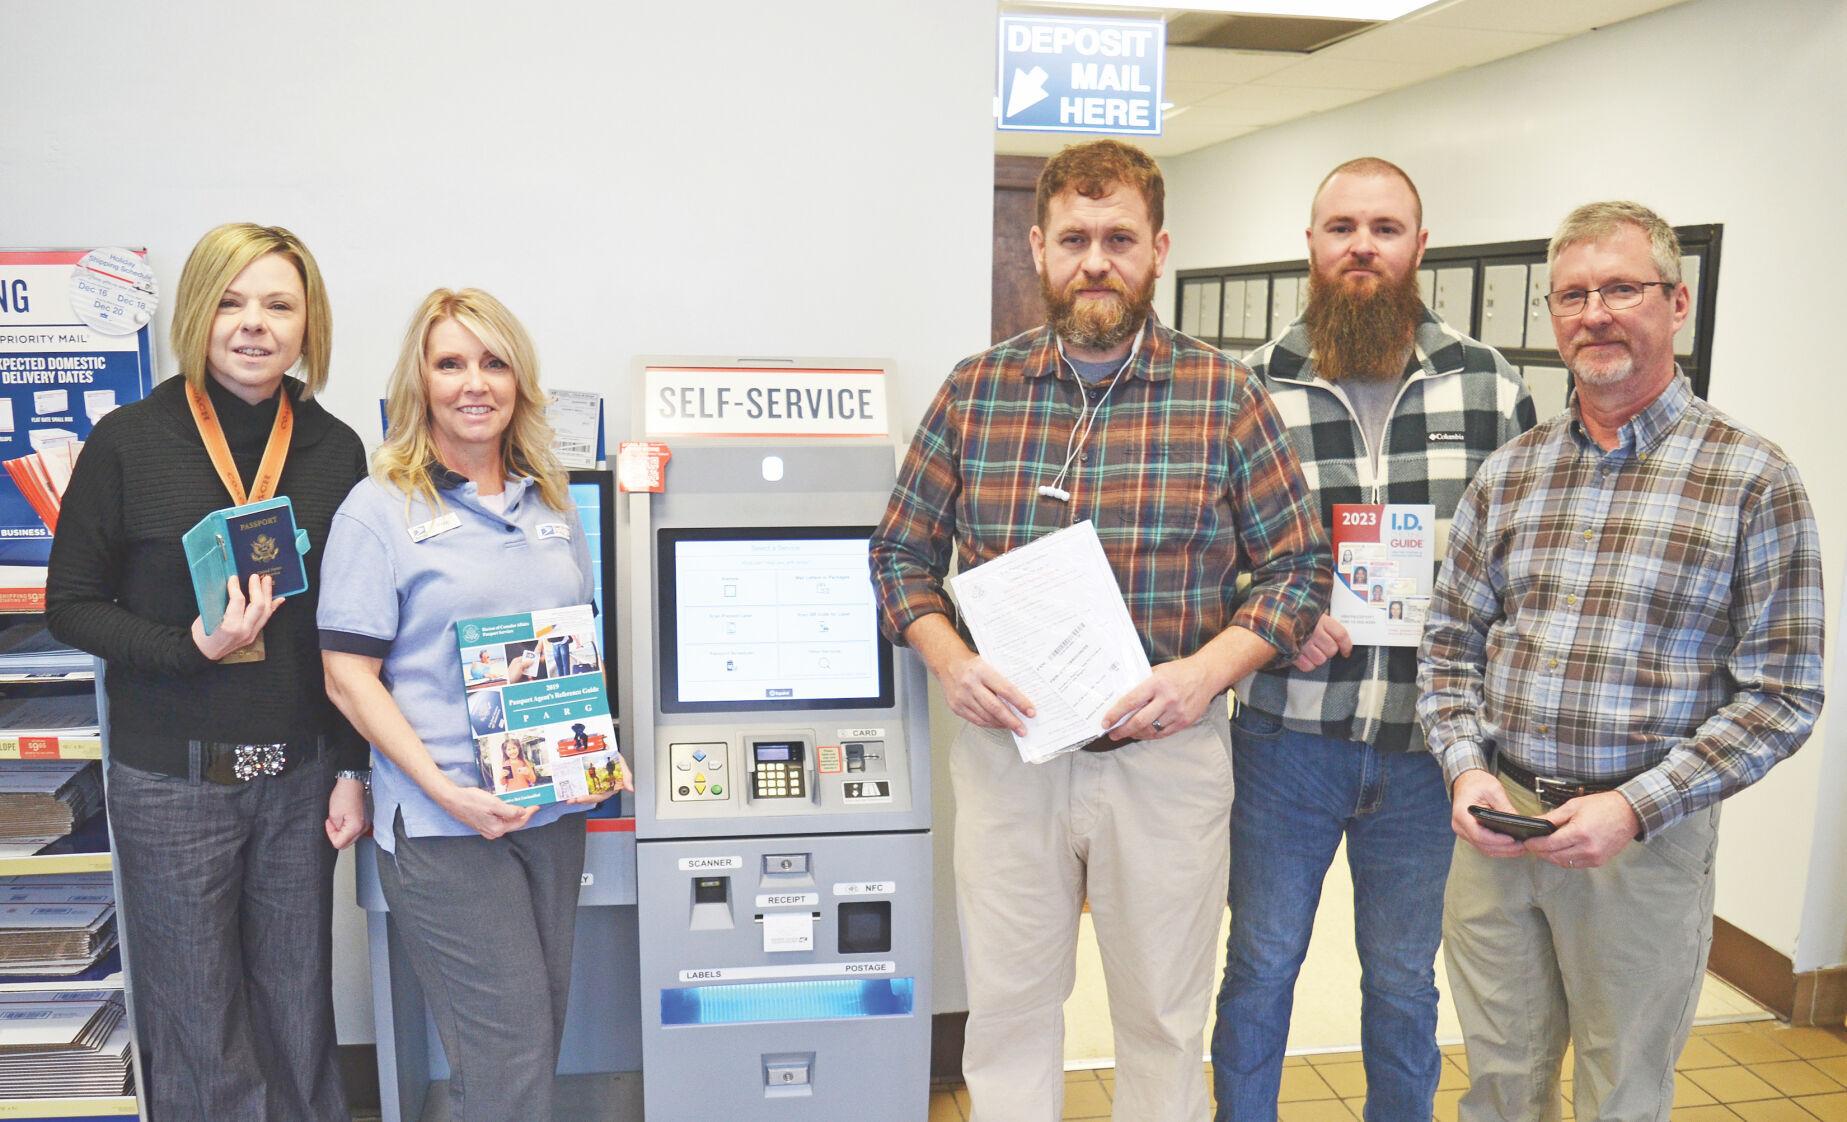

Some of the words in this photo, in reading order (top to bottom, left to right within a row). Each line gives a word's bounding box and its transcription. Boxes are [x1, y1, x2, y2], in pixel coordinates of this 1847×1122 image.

[1007, 24, 1152, 58] DEPOSIT
[1071, 62, 1151, 92] MAIL
[1059, 96, 1150, 127] HERE
[78, 281, 96, 293] Dec
[117, 294, 134, 306] Dec
[94, 300, 111, 312] Dec
[112, 307, 124, 316] 20
[0, 335, 54, 344] PRIORITY
[58, 334, 87, 343] MAIL
[47, 356, 107, 370] DOMESTIC
[1, 371, 56, 385] DELIVERY
[58, 370, 94, 384] DATES
[658, 386, 874, 420] SELF-SERVICE
[1436, 433, 1465, 441] Columbia
[240, 515, 279, 532] PASSPORT
[1342, 511, 1377, 526] 2023
[1391, 513, 1423, 531] I.D.
[0, 528, 46, 537] BUSINESS
[1390, 538, 1424, 549] GUIDE
[508, 697, 533, 706] Passport
[554, 689, 582, 699] Reference
[581, 686, 600, 695] Guide
[523, 714, 530, 723] P
[543, 711, 550, 720] A
[563, 707, 571, 716] R
[584, 704, 593, 712] G
[852, 729, 878, 737] CARD
[688, 858, 732, 868] SCANNER
[865, 884, 884, 893] NFC
[768, 895, 806, 904] RECEIPT
[845, 963, 887, 973] POSTAGE
[686, 970, 722, 980] LABELS
